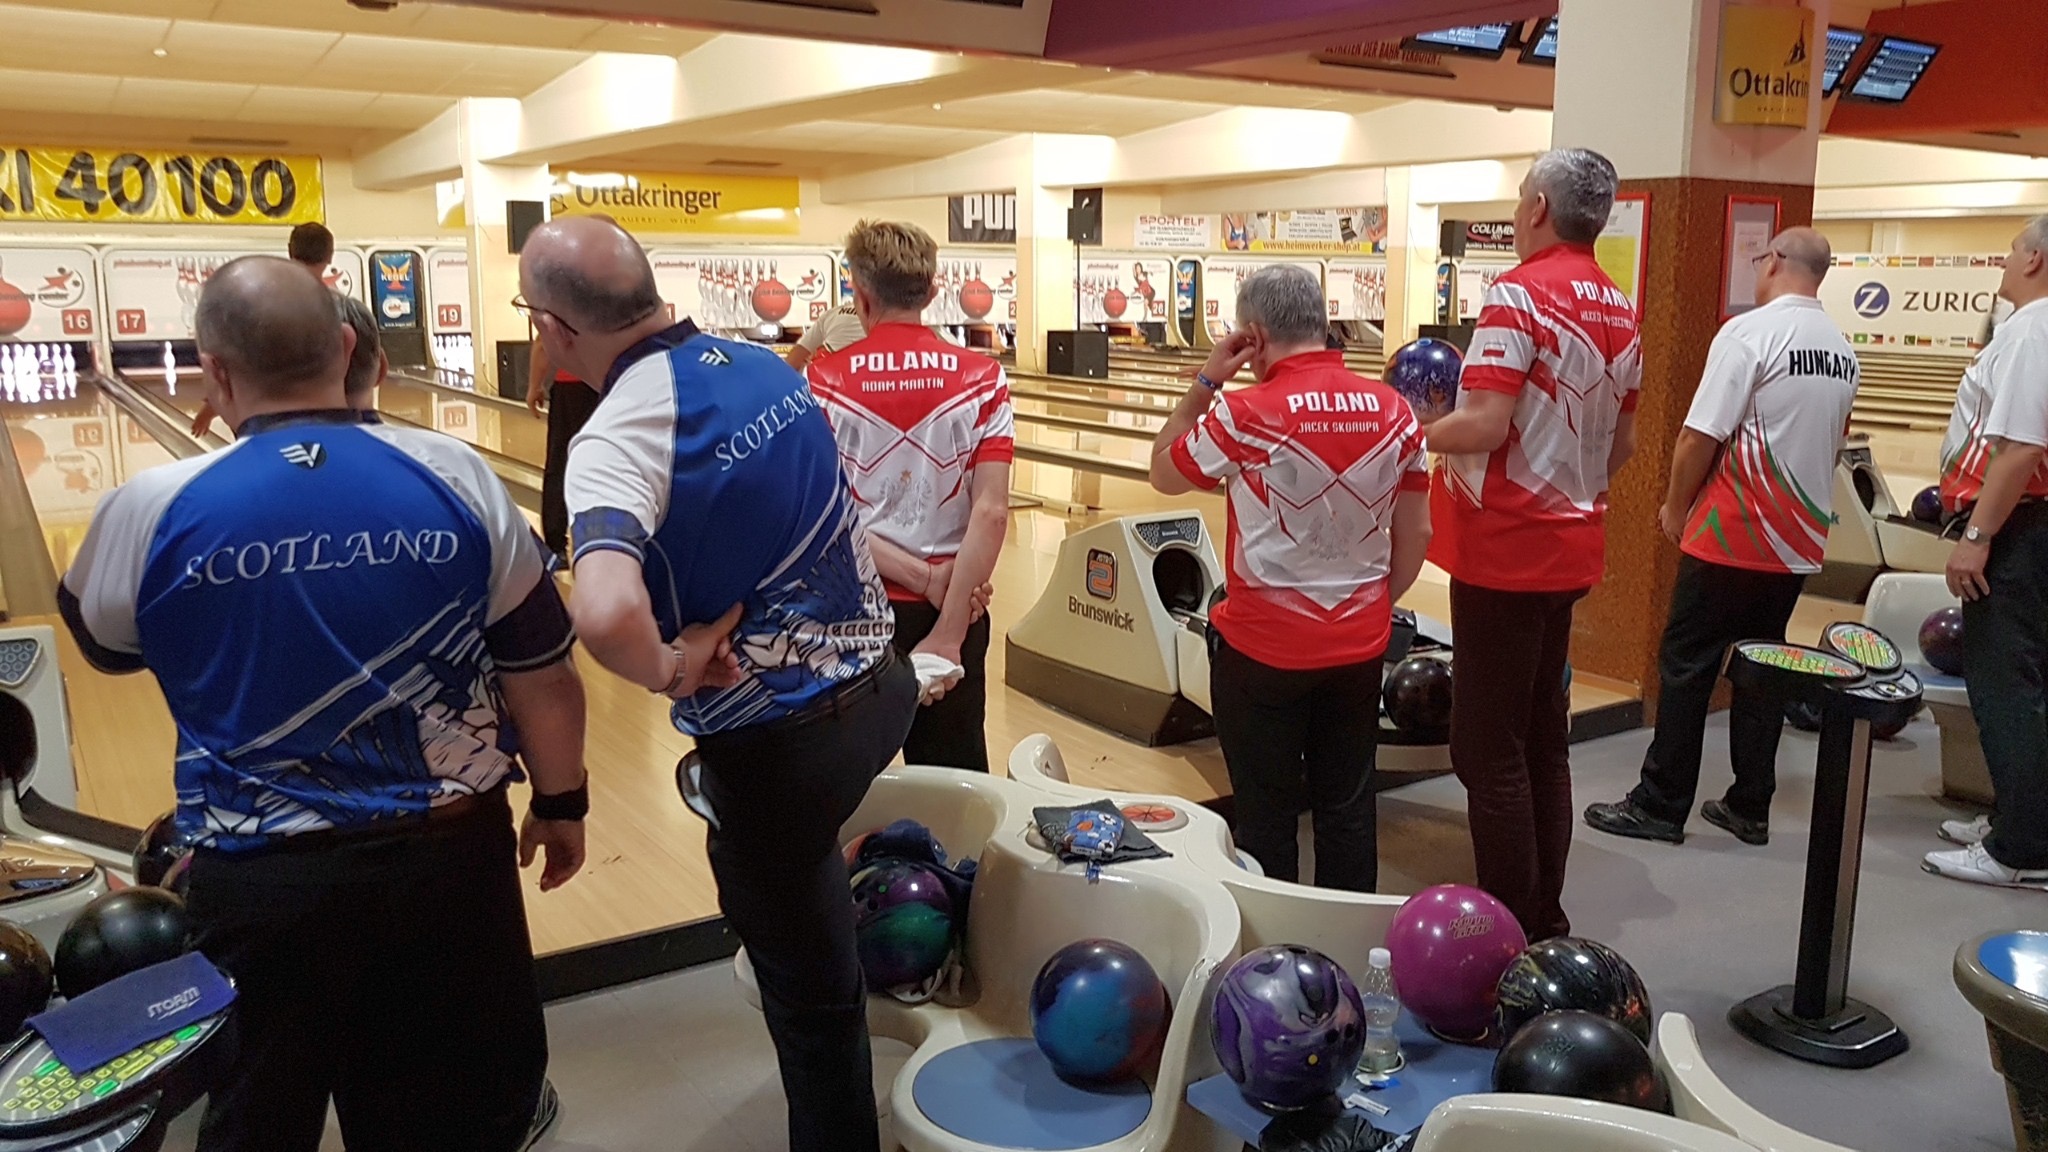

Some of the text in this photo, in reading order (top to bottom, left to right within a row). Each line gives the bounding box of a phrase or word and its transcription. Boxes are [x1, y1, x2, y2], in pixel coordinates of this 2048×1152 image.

[54, 151, 297, 219] 40100
[575, 180, 722, 215] Ottakringer
[1570, 280, 1629, 311] POLAND
[65, 313, 89, 330] 16
[119, 313, 141, 329] 17
[440, 308, 459, 323] 19
[850, 351, 958, 374] POLAND
[1789, 349, 1856, 385] HUNGARY
[862, 377, 944, 392] ADAM MARTIN
[1286, 391, 1380, 414] POLAND
[1298, 421, 1329, 433] JACEK
[181, 528, 459, 590] SCOTLAND
[1068, 595, 1135, 633] Brunswick
[147, 986, 201, 1018] STORM
